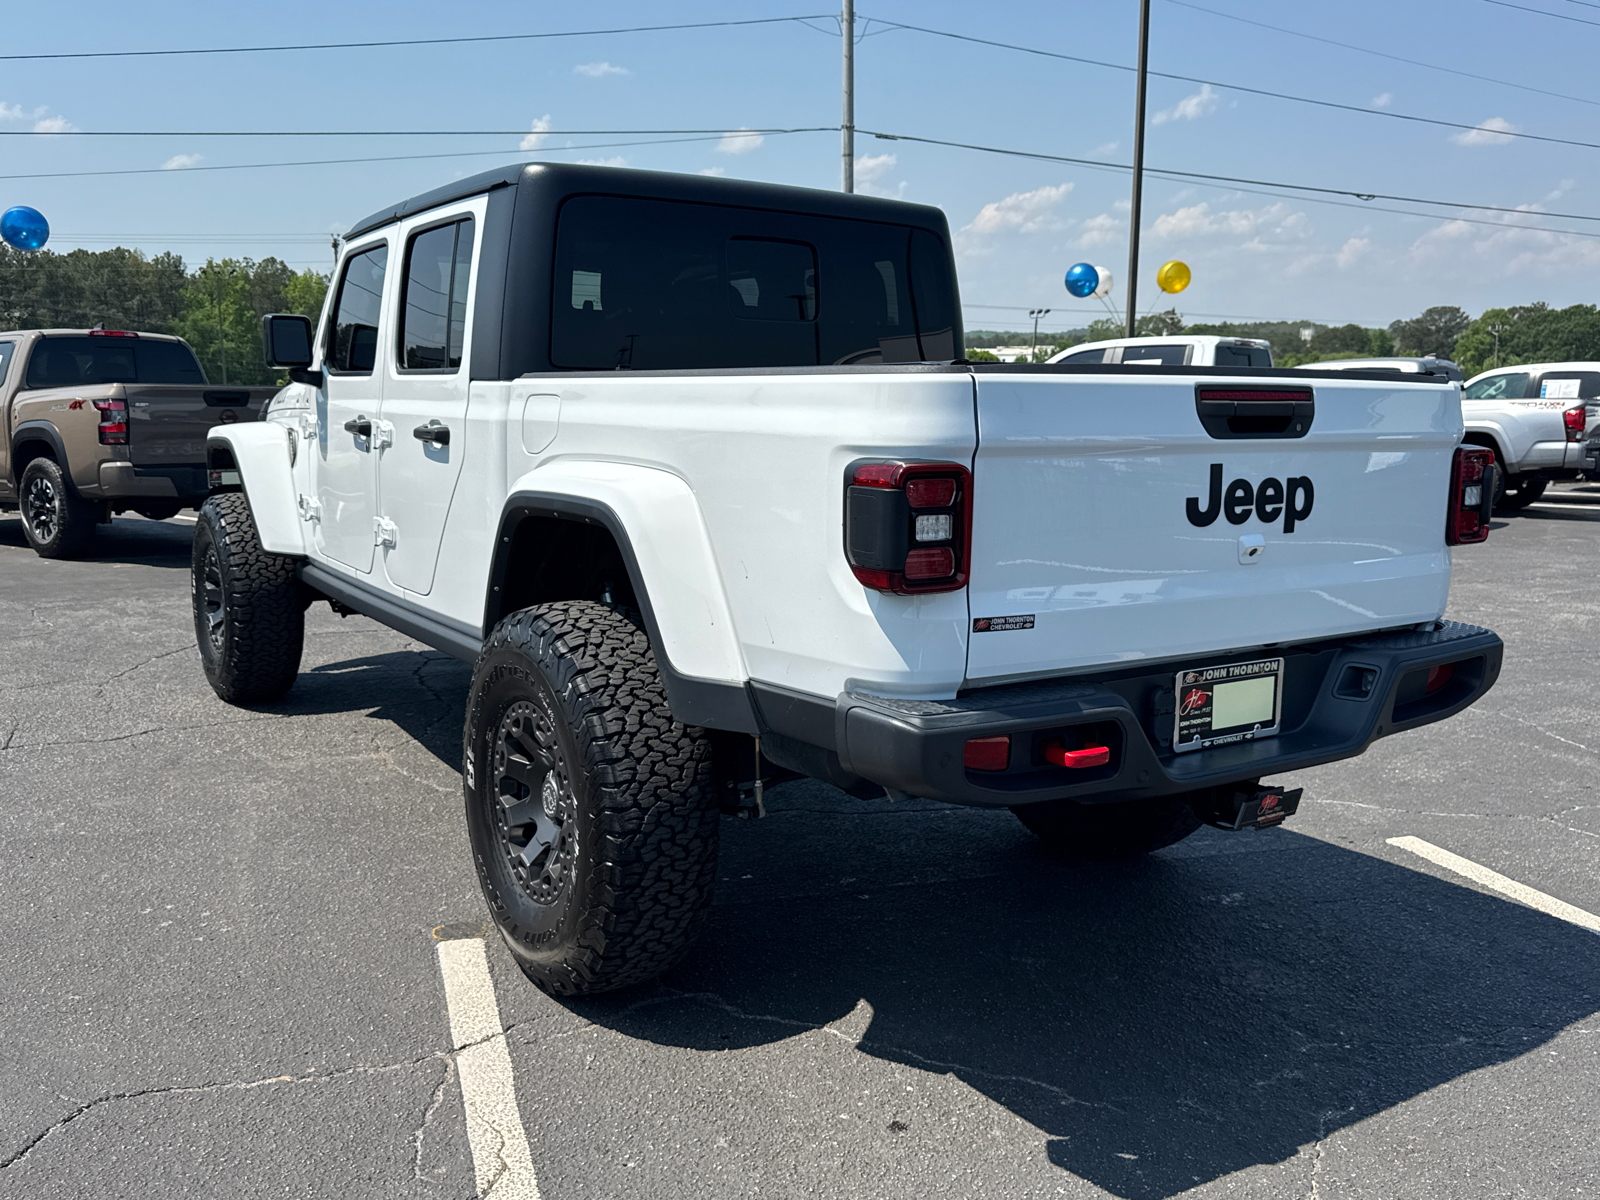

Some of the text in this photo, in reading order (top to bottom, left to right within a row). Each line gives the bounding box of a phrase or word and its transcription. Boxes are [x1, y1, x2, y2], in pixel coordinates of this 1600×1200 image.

[1186, 463, 1314, 533] Jeep
[1202, 669, 1227, 680] JOHN
[1229, 661, 1278, 677] THORNTON
[1189, 716, 1212, 725] THORNTON
[1213, 735, 1244, 746] CHEVROLET
